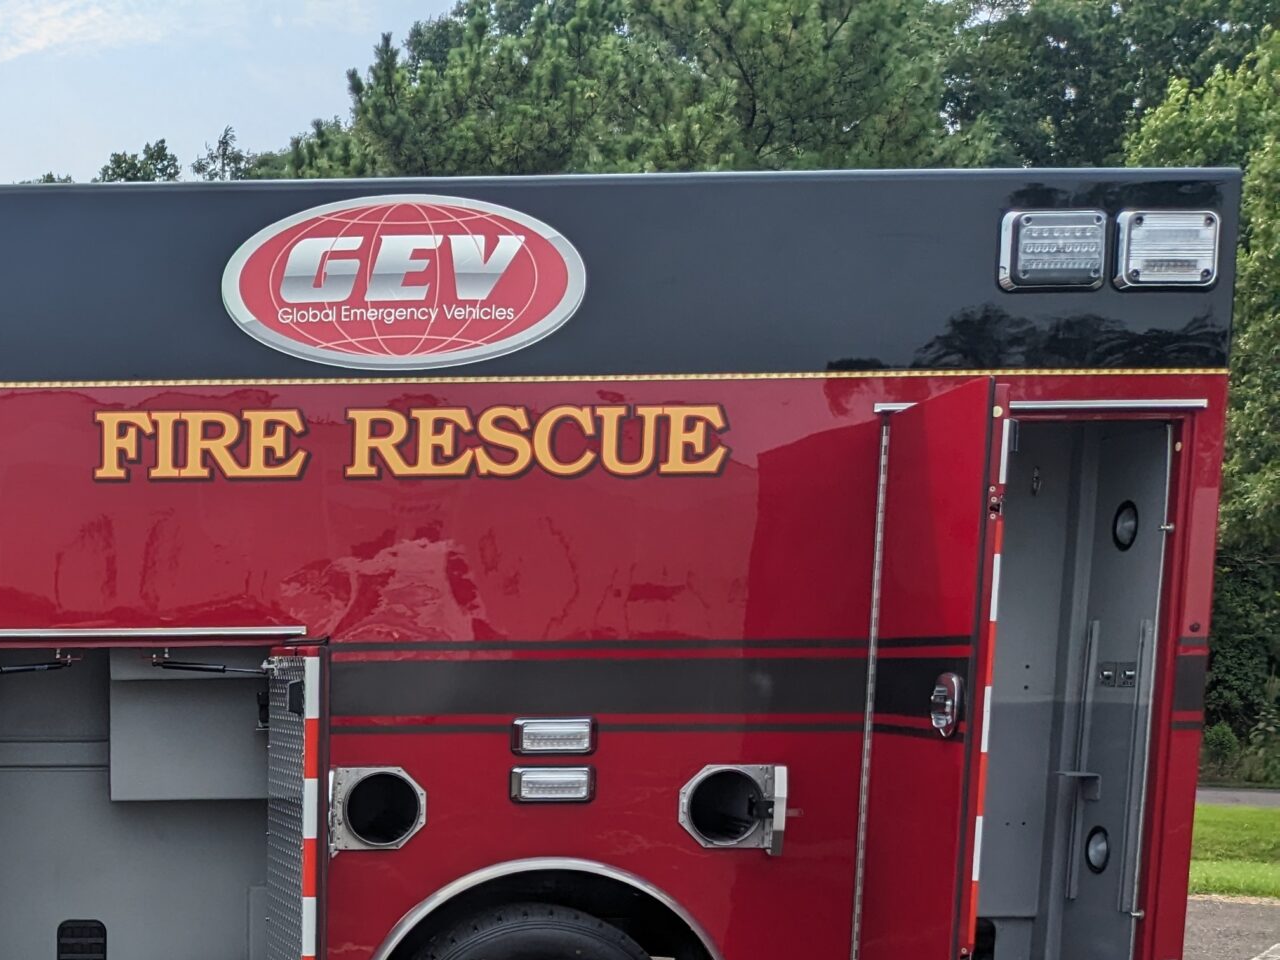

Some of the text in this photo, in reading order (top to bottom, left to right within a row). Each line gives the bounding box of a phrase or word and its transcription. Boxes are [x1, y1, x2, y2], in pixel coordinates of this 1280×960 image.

[279, 234, 525, 303] GEV
[277, 304, 514, 324] Global Emergency Vehicles
[93, 403, 732, 482] FIRE RESCUE
